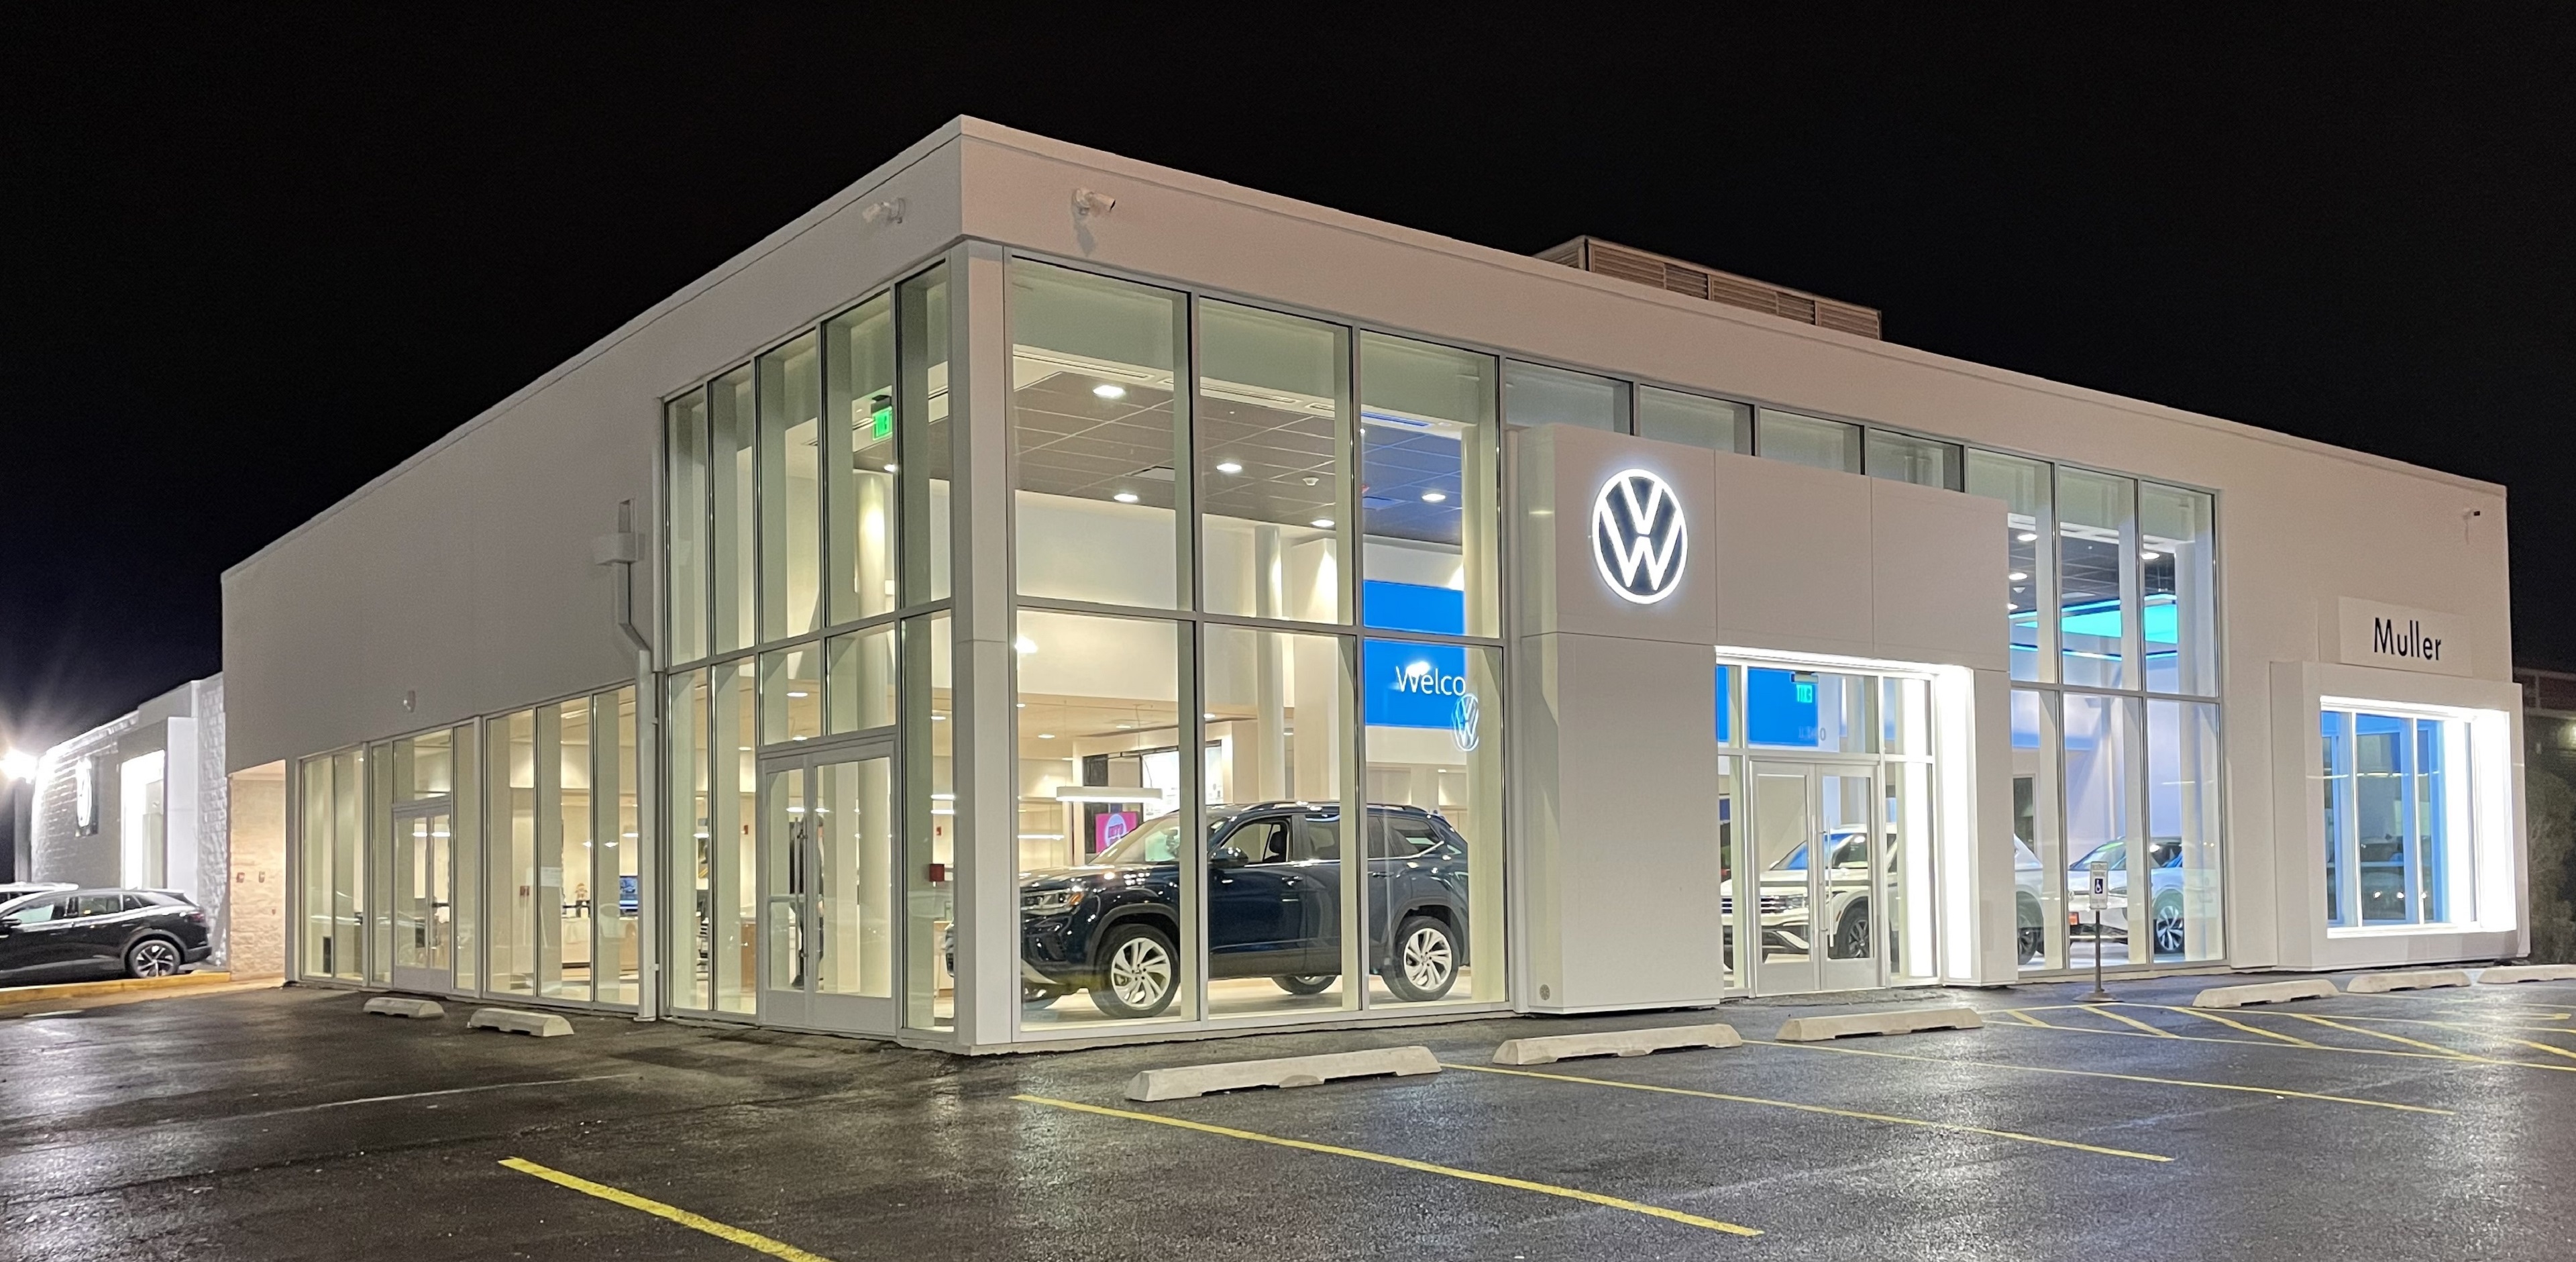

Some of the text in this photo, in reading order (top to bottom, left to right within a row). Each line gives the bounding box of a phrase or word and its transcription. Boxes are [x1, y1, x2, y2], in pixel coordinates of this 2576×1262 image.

[1595, 471, 1685, 596] VW
[2374, 617, 2441, 661] Muller
[1395, 666, 1466, 696] Welco
